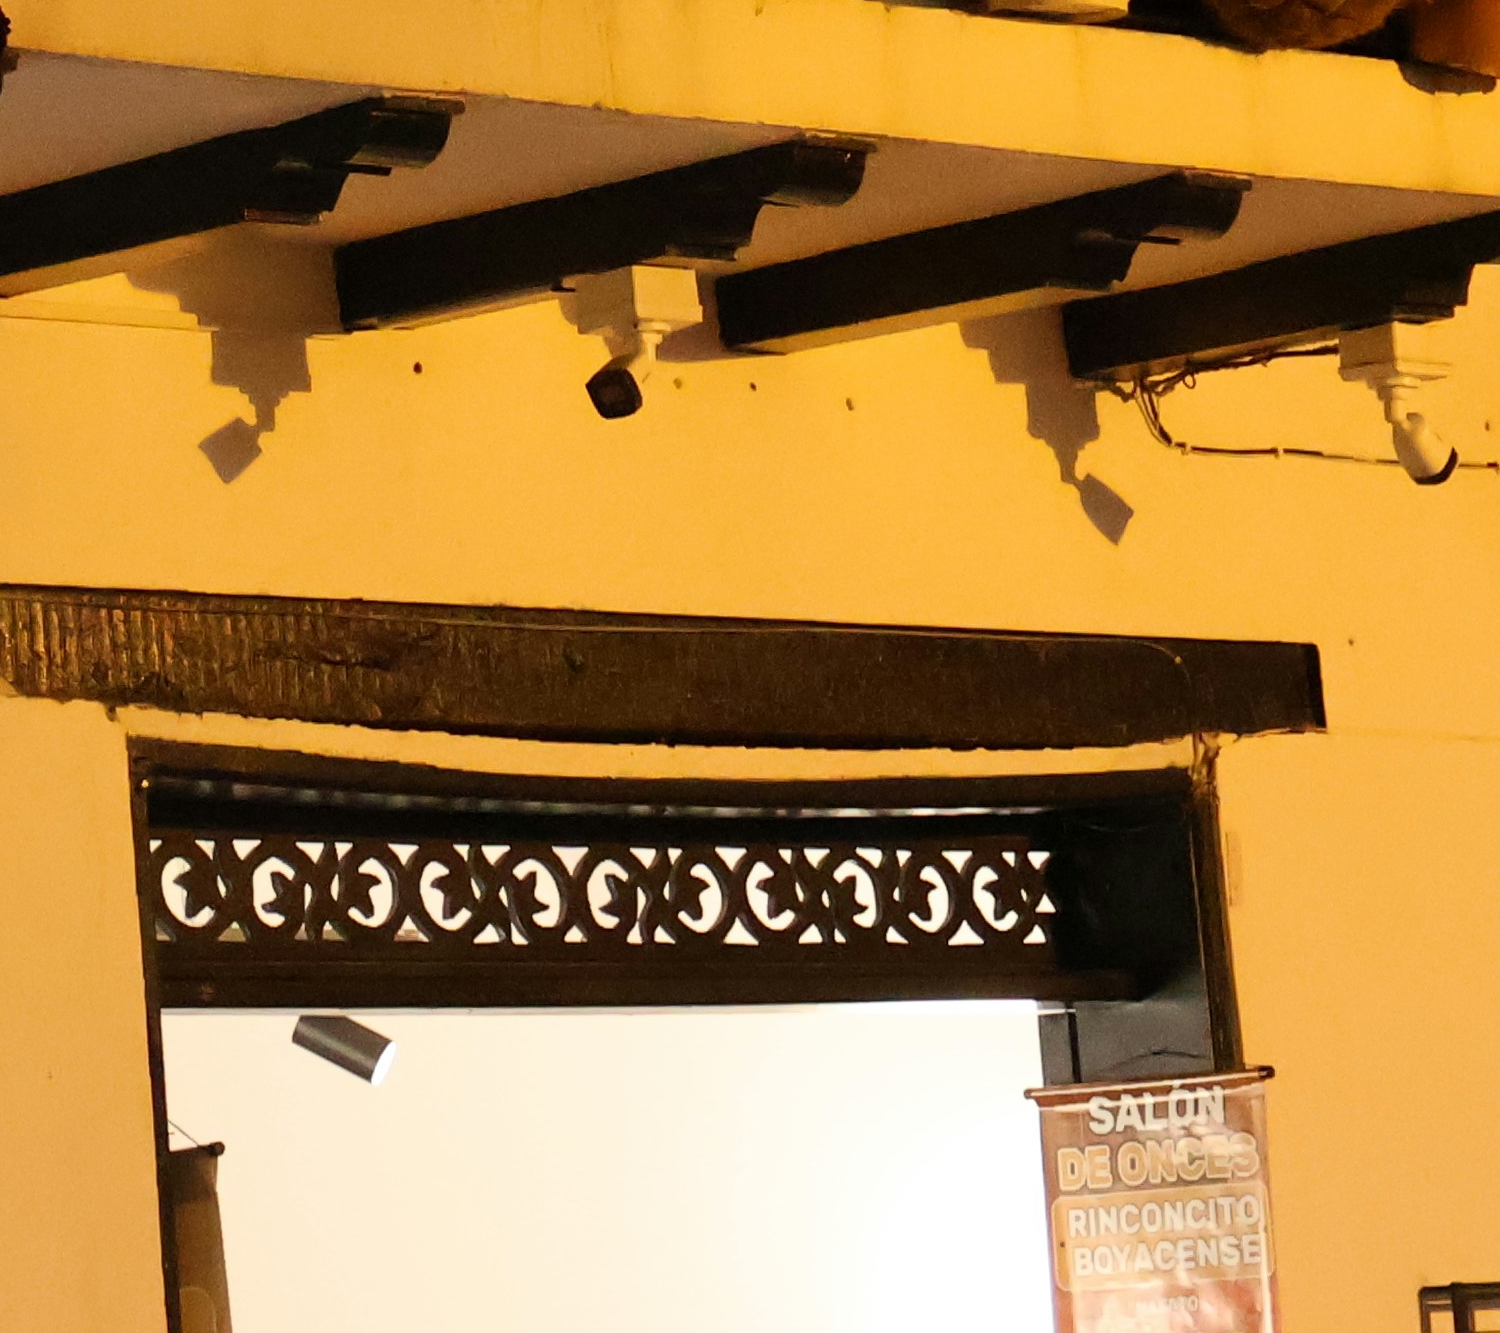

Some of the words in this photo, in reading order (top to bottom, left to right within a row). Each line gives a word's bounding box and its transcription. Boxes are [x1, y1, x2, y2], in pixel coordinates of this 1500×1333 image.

[1088, 1081, 1225, 1134] SALÓN
[1057, 1145, 1113, 1191] DE
[1117, 1132, 1260, 1186] ONCES
[1068, 1194, 1260, 1238] RINCONCITO
[1073, 1234, 1262, 1277] BOYACENSE
